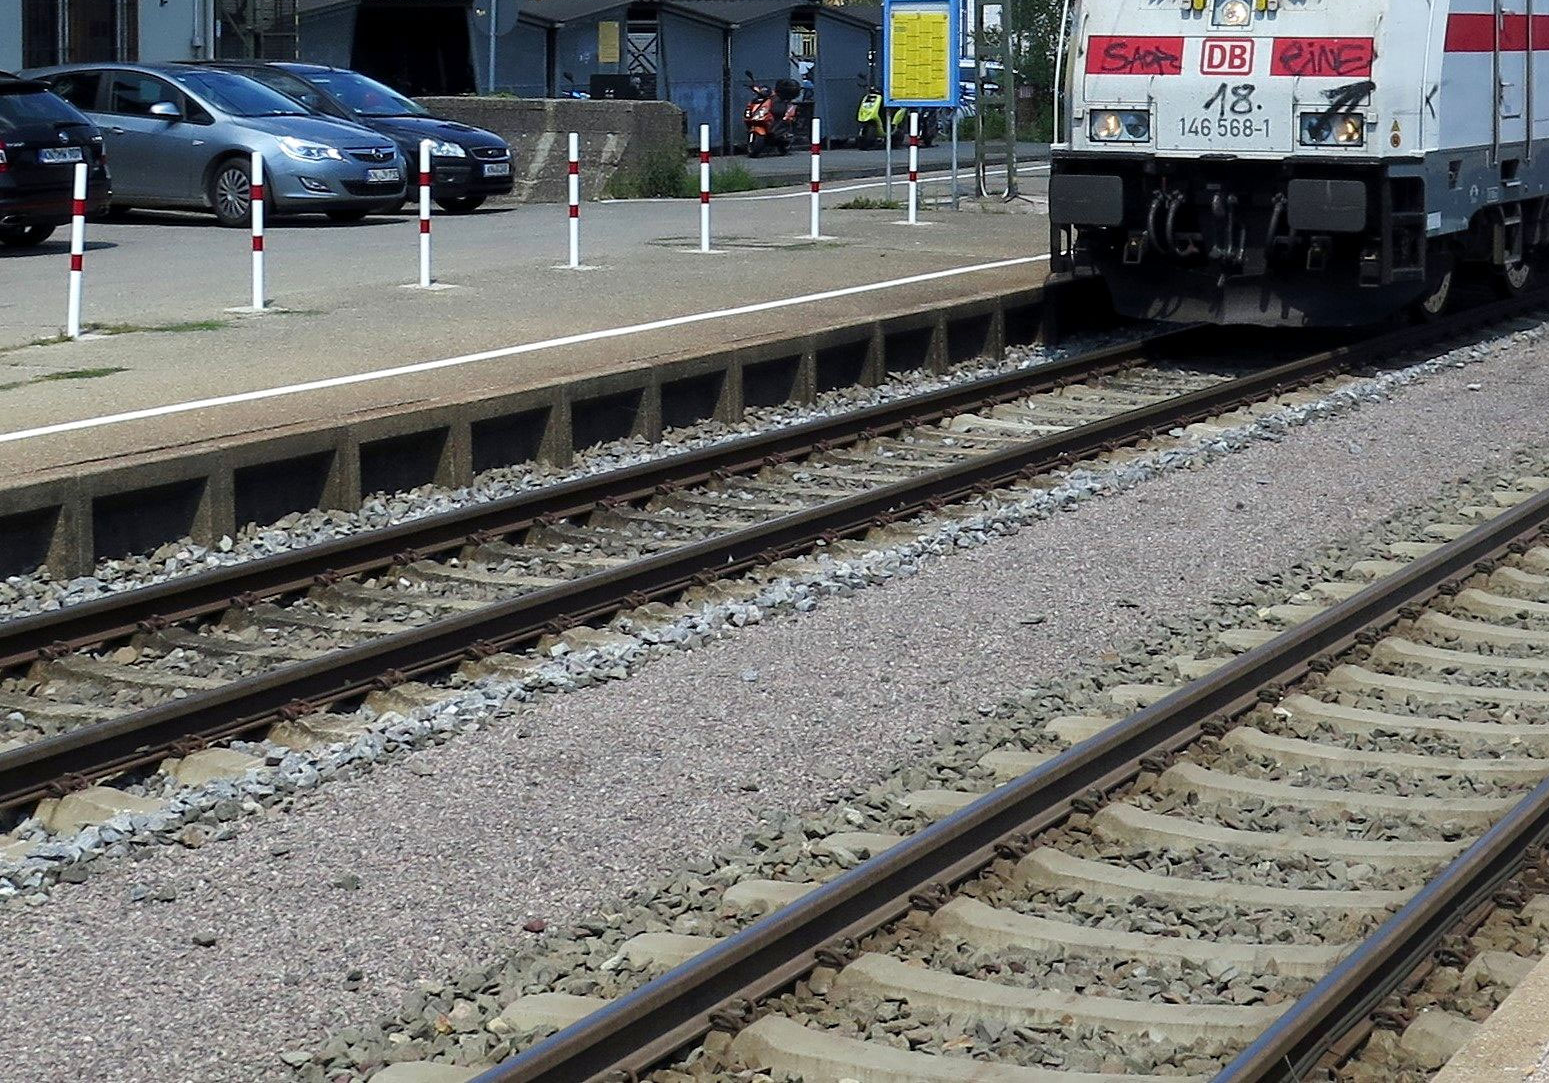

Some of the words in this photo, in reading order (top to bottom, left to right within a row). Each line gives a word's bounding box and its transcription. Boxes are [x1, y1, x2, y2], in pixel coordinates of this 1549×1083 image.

[1207, 44, 1248, 70] DB
[1179, 117, 1211, 138] 146
[1217, 118, 1271, 138] 568-1
